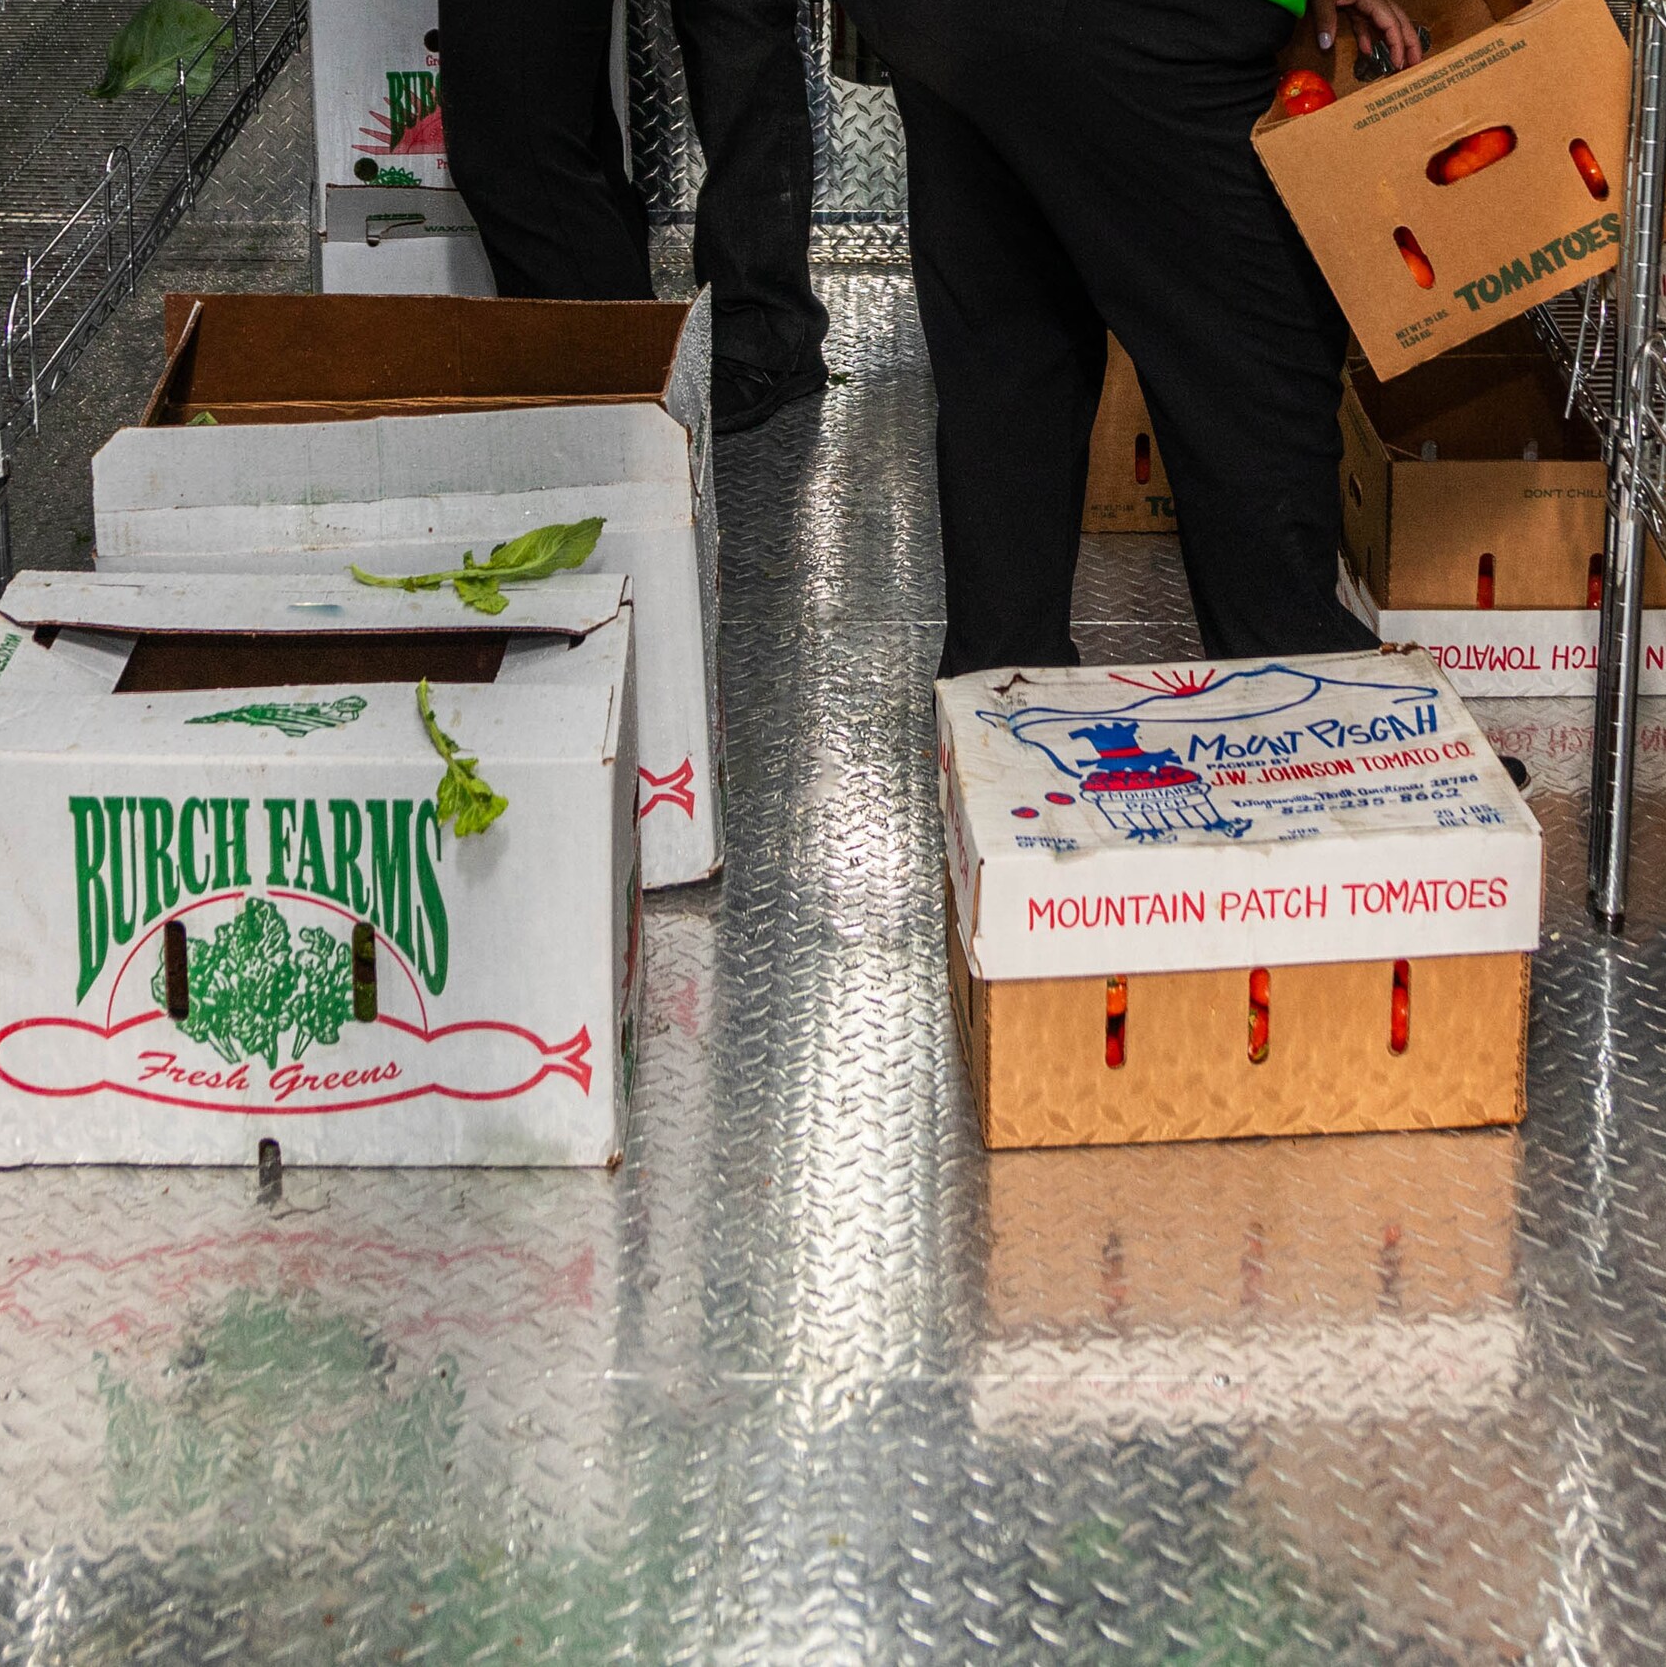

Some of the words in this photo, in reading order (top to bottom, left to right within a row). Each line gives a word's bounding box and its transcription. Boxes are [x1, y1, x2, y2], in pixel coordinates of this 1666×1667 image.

[1353, 112, 1381, 131] COATED
[1380, 104, 1400, 119] WITH
[1405, 91, 1424, 108] FOOD
[1424, 81, 1450, 99] GRADE
[1447, 60, 1487, 87] PETROLEUM
[1486, 48, 1511, 69] BASED
[1510, 38, 1528, 54] WAX
[1364, 103, 1376, 113] TO
[1376, 88, 1410, 109] MAINTAIN
[1409, 67, 1450, 95] FRESHNESS
[1448, 59, 1466, 73] THIS
[1465, 44, 1498, 67] PRODUCT
[1496, 38, 1506, 48] IS
[1454, 212, 1620, 312] TOMATOES
[1524, 489, 1562, 499] DON'T
[1567, 489, 1605, 498] CHILL
[1428, 644, 1541, 671] TOMATOE
[1305, 704, 1438, 749] PISGAH
[1206, 759, 1266, 770] PACKED
[1270, 756, 1291, 767] BY
[1211, 770, 1253, 787] J.W.
[1257, 759, 1355, 784] JOHNSON
[1356, 747, 1439, 773] TOMATO
[1442, 740, 1475, 759] CO.
[1126, 799, 1188, 811] PATCH
[69, 796, 252, 1007] BURCH
[263, 798, 449, 996] FARMS
[1028, 891, 1205, 931] MOUNTAIN
[1219, 884, 1328, 922] PATCH
[1342, 877, 1509, 916] TOMATOES
[137, 1051, 250, 1090] Fresh
[269, 1060, 403, 1102] Greens
